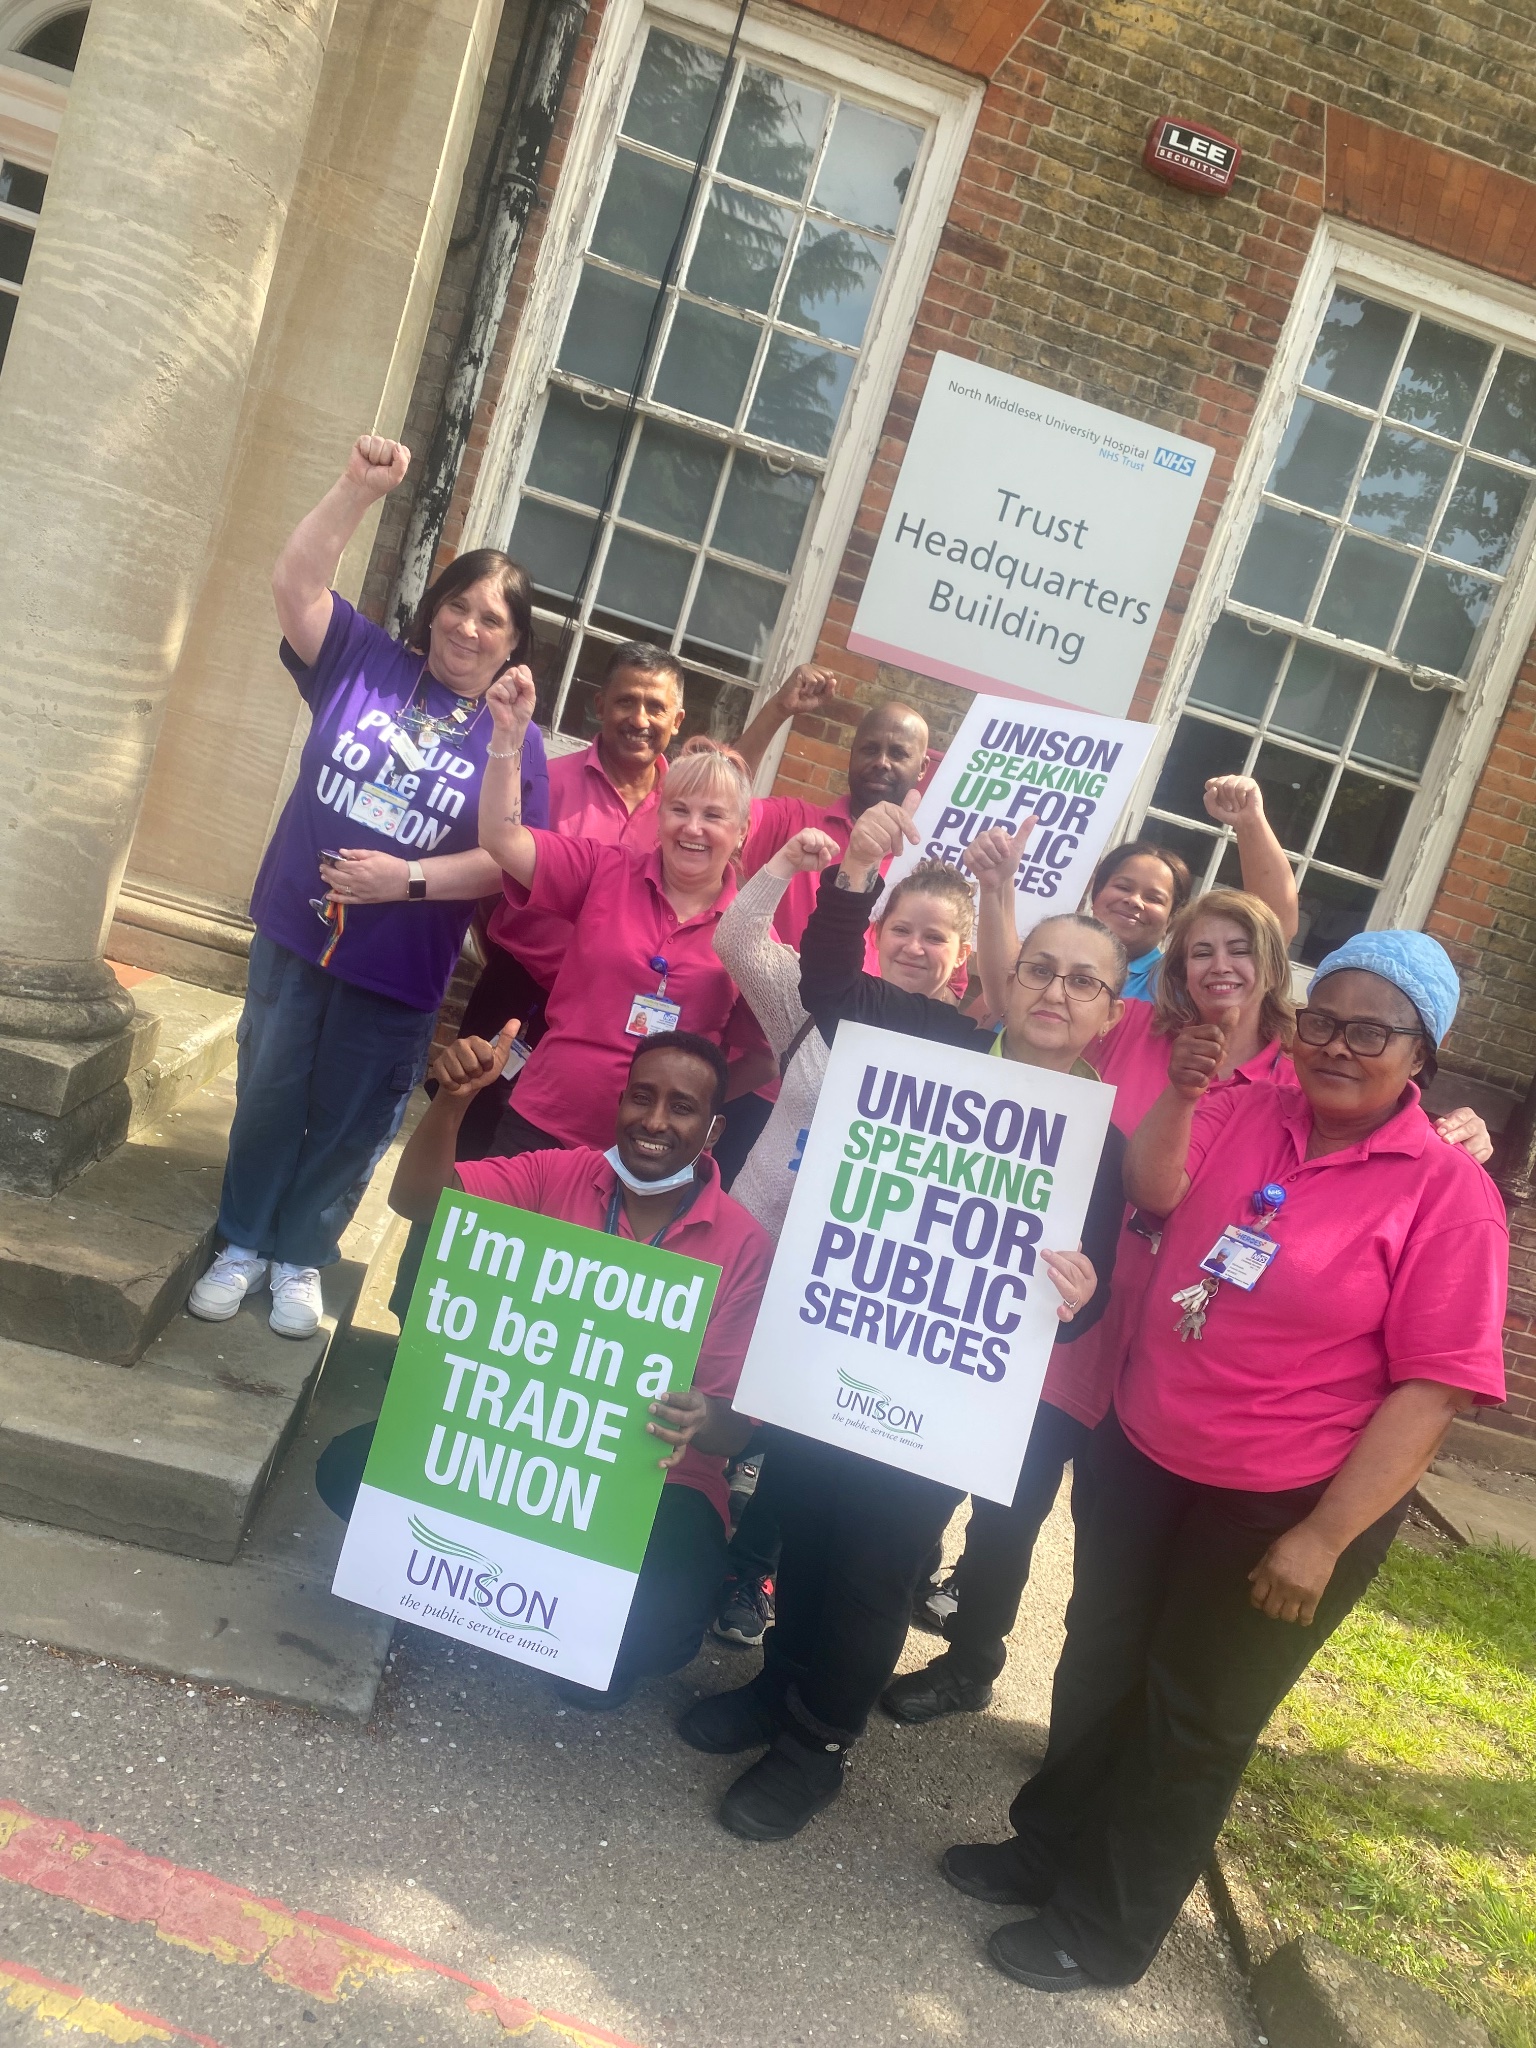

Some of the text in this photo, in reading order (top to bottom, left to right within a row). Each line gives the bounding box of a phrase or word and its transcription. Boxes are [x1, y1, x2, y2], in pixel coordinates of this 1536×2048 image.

[1169, 130, 1227, 165] LEE
[948, 380, 1149, 460] North Middlesex University Hospital
[1099, 448, 1145, 471] NHS Trust
[1154, 448, 1196, 476] NHS
[997, 488, 1089, 549] Trust
[894, 512, 1150, 625] Headquarters
[928, 579, 1085, 665] Building
[331, 730, 370, 771] to
[426, 775, 466, 819] in
[967, 750, 1108, 798] SPEAKING
[980, 719, 1123, 773] UNISON
[316, 765, 452, 851] UNON
[951, 772, 1097, 835] UP FOR
[856, 1064, 1067, 1168] UNISON
[844, 1121, 1053, 1212] SPEAKING
[829, 1161, 1044, 1276] UP FOR
[437, 1206, 525, 1282] I'm
[531, 1248, 704, 1333] proud
[811, 1222, 1027, 1335] PUBLIC
[425, 1279, 673, 1400] to be in a
[799, 1282, 1011, 1383] SERVICES
[441, 1353, 628, 1464] TRADE
[832, 1412, 924, 1450] the public service union
[837, 1387, 923, 1433] UNISON
[424, 1424, 601, 1532] UNION
[400, 1593, 559, 1659] the public service union
[407, 1549, 559, 1629] UNISON
